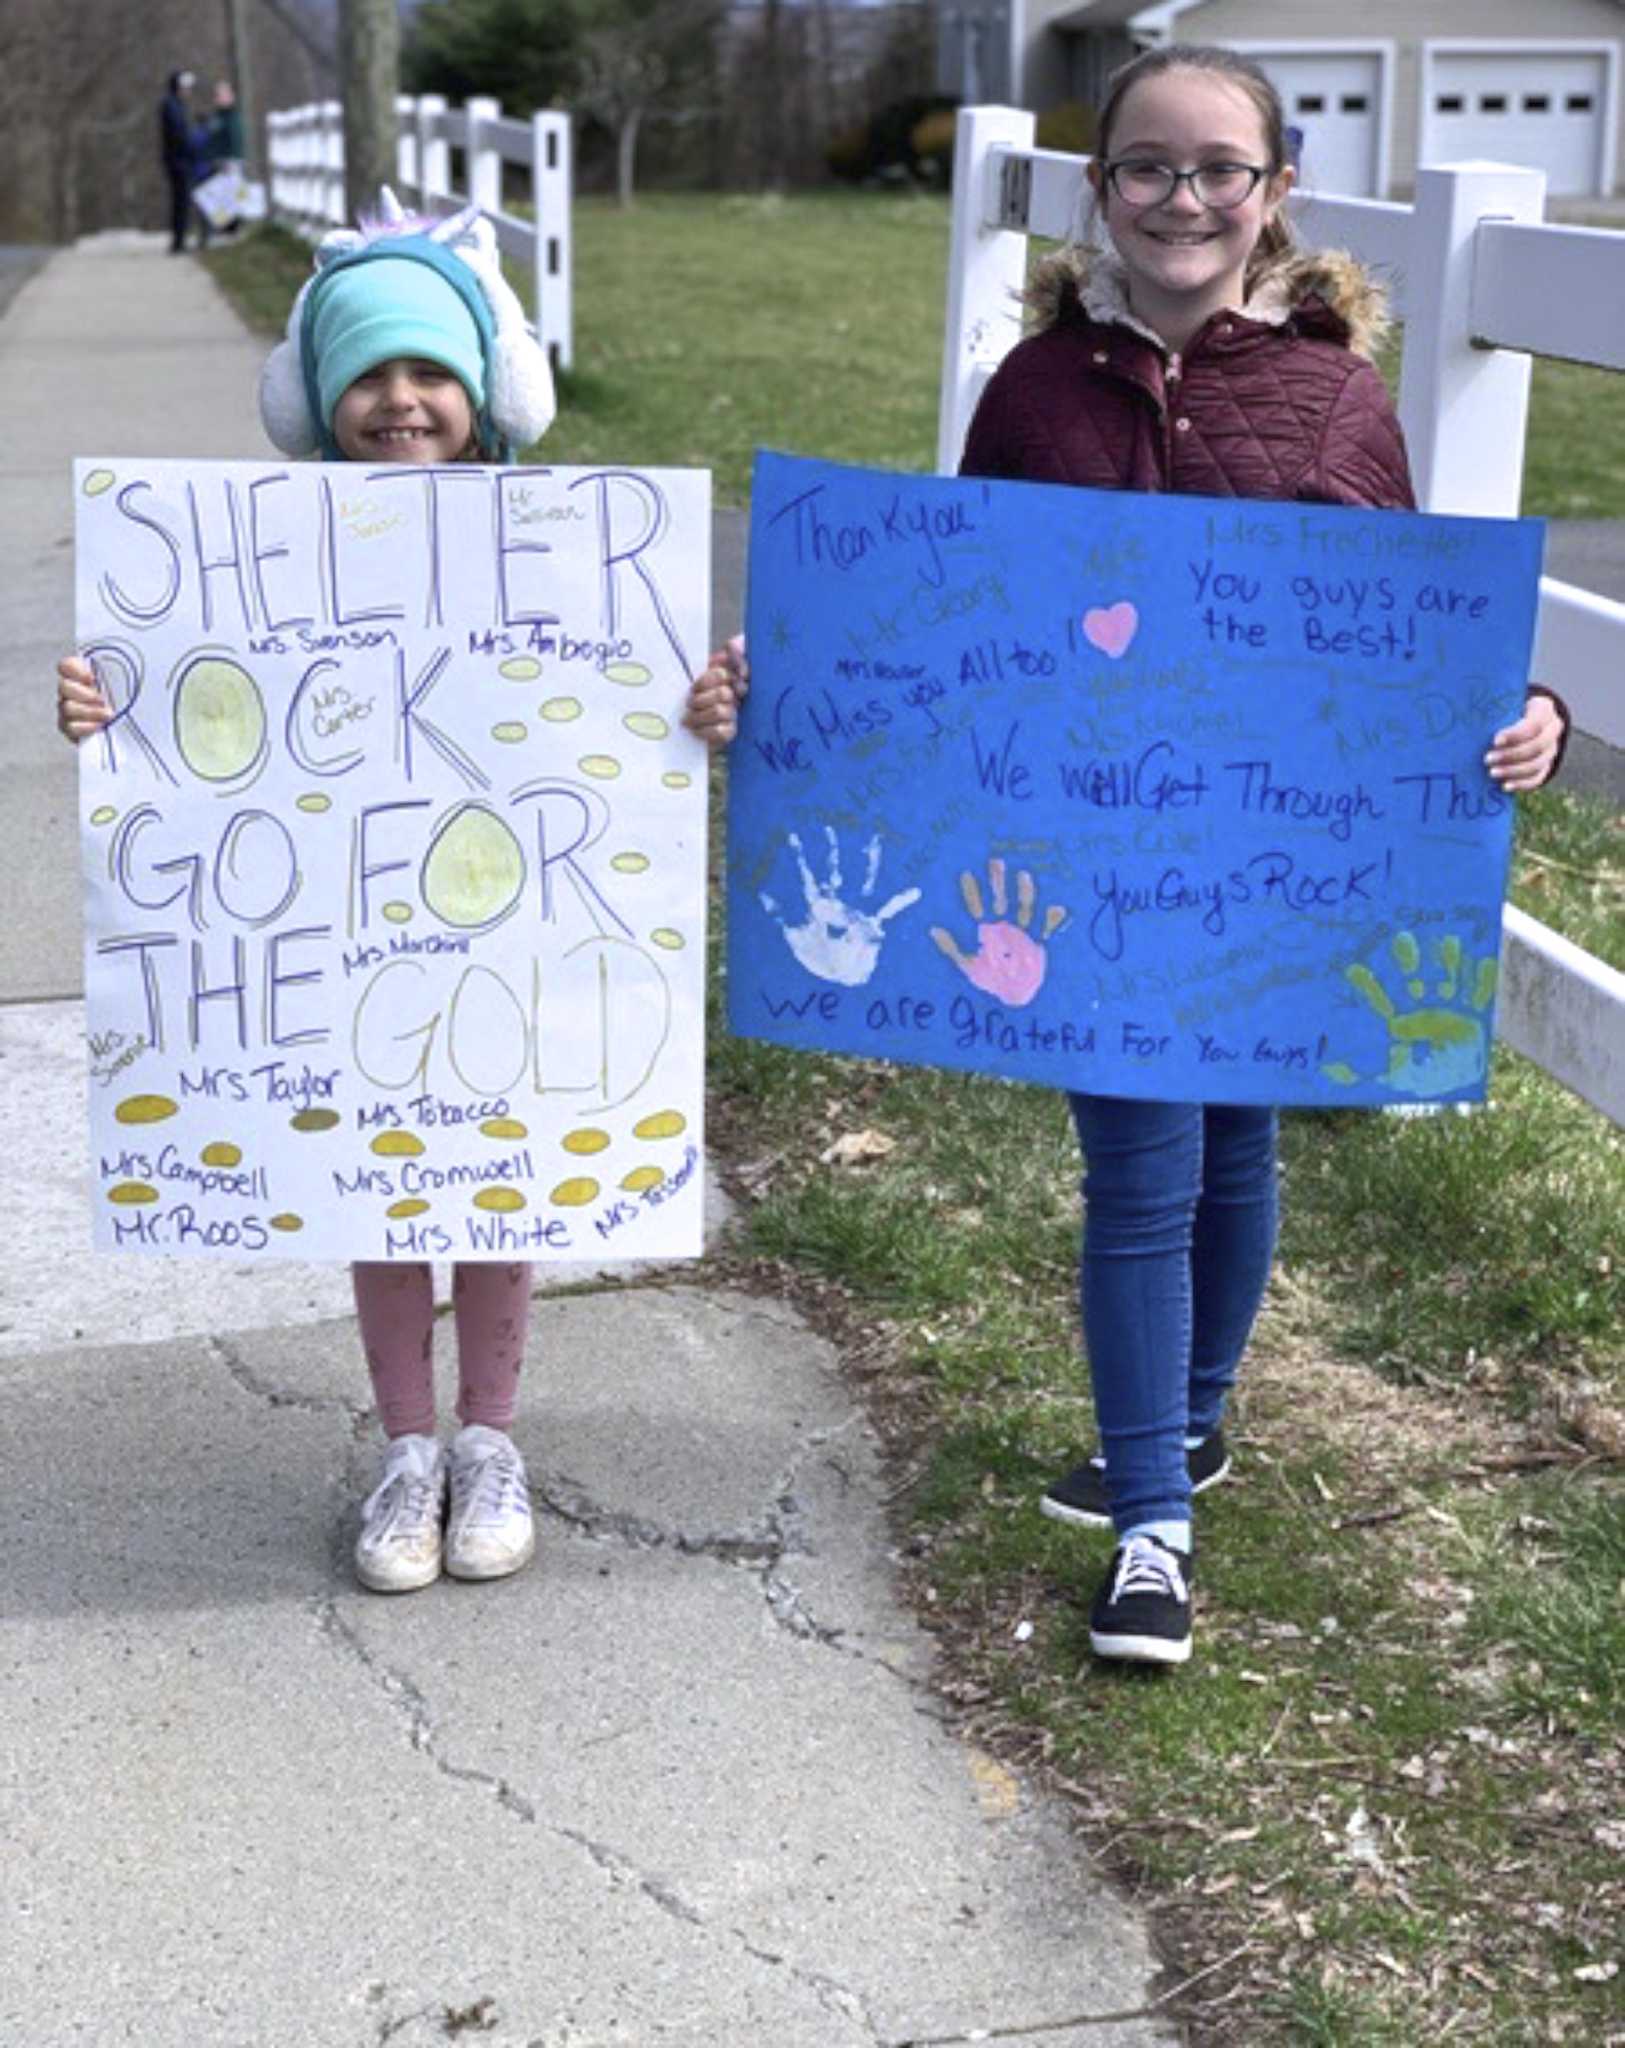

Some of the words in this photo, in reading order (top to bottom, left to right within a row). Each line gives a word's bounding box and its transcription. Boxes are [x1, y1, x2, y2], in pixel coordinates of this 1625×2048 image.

[98, 468, 694, 682] SHELTER
[1189, 558, 1262, 604] You
[1291, 575, 1395, 620] guys
[1416, 584, 1490, 620] are
[469, 630, 515, 656] Mrs
[1203, 607, 1268, 648] the
[1304, 615, 1417, 662] Best!
[80, 637, 491, 794] ROCK
[754, 686, 814, 774] We
[961, 639, 1005, 688] All
[969, 720, 1033, 801] We
[1224, 761, 1386, 842] Through
[109, 802, 303, 931] GO
[347, 778, 635, 938] FOR
[343, 945, 385, 978] Mrs
[97, 925, 331, 1052] THE
[352, 936, 672, 1116] GOLD
[866, 994, 936, 1031] are
[1121, 1020, 1172, 1058] For
[1195, 1032, 1241, 1063] You
[179, 1066, 250, 1102] Mrs
[250, 1061, 341, 1113] Taylor
[357, 1103, 402, 1130] Mrs
[408, 1095, 510, 1127] Tobacco
[101, 1150, 151, 1180] Mrs
[157, 1144, 269, 1201] Campbell
[333, 1167, 395, 1198] Mrs
[400, 1149, 535, 1194] Cromwell
[168, 1203, 269, 1251] Roos
[386, 1221, 451, 1257] Mrs
[466, 1215, 573, 1252] White
[593, 1200, 640, 1239] Mrs
